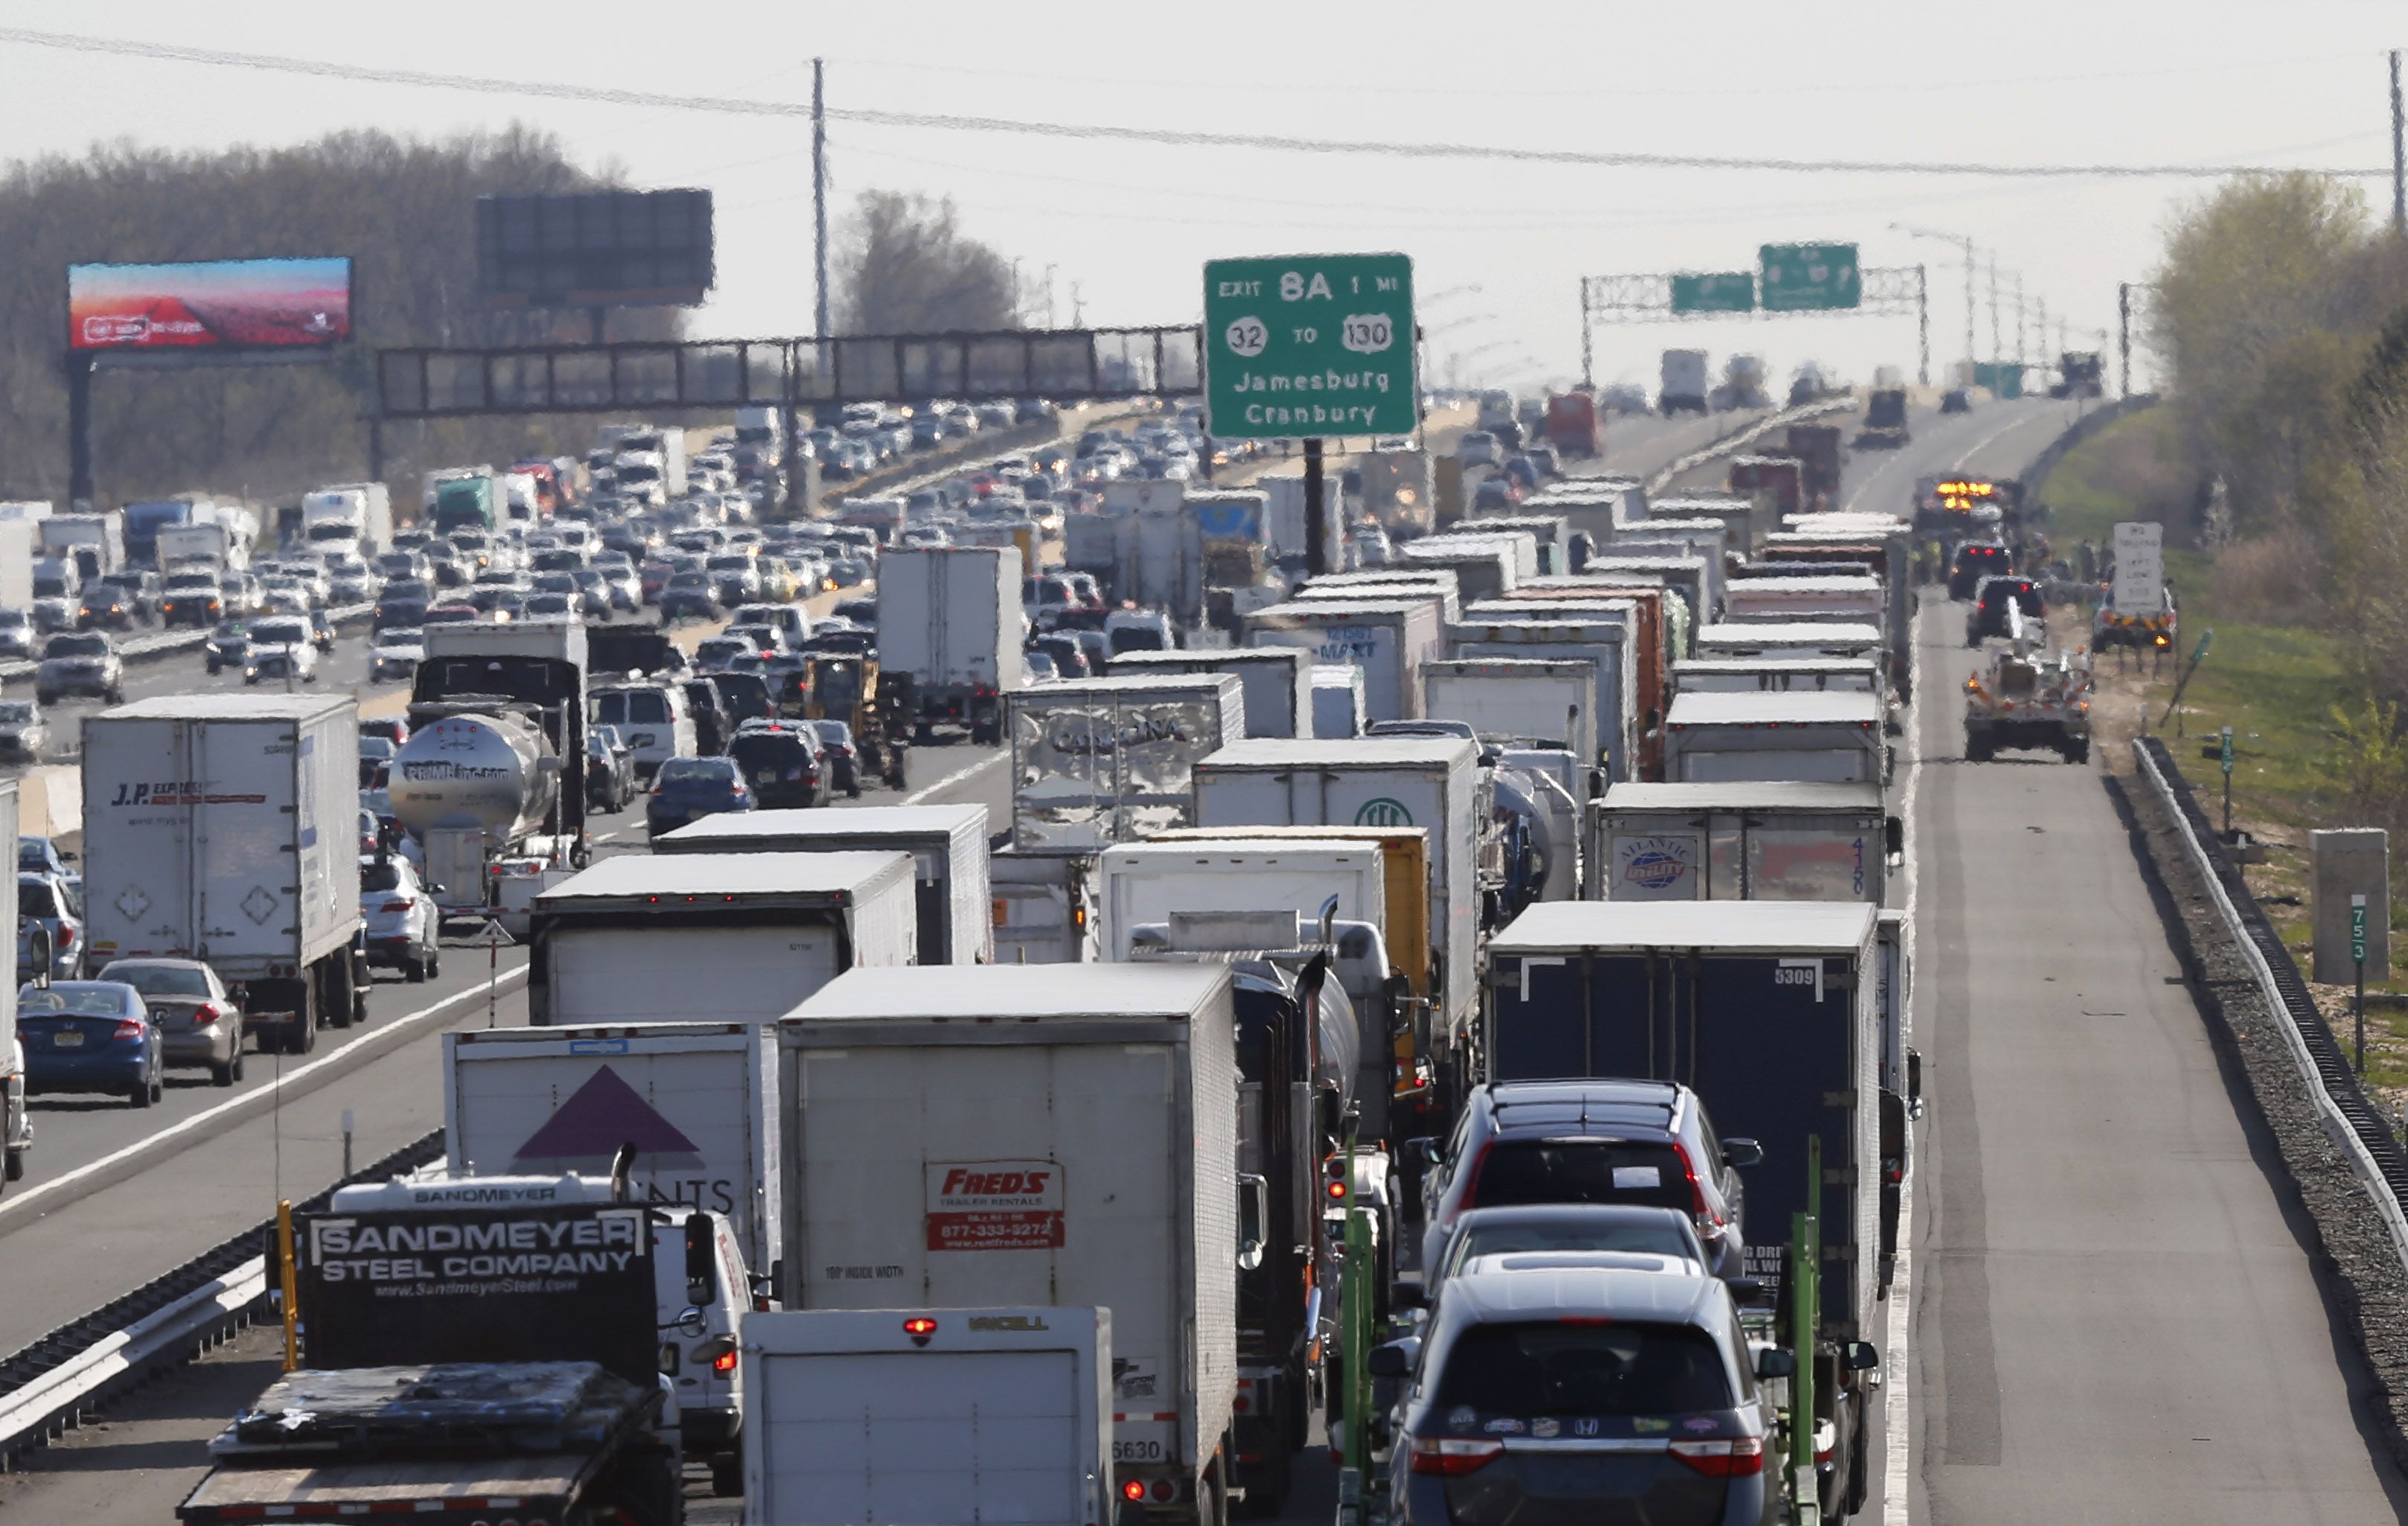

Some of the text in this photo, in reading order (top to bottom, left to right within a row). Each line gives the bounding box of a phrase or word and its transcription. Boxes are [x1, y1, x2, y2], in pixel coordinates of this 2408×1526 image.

[1219, 272, 1397, 301] EXIT 8A 1 MI
[1230, 324, 1387, 348] 32 TO 130
[1233, 370, 1388, 392] Jamesburg
[1245, 404, 1376, 426] Cranbury
[111, 784, 149, 806] J.P.
[1621, 837, 1690, 861] ATLANTIC
[415, 1188, 556, 1203] SANDMEYER
[991, 1197, 1043, 1206] RENTALS
[321, 1218, 635, 1254] SANDMEYER
[322, 1252, 633, 1281] STEEL COMPANY
[877, 1265, 904, 1278] WIDTH
